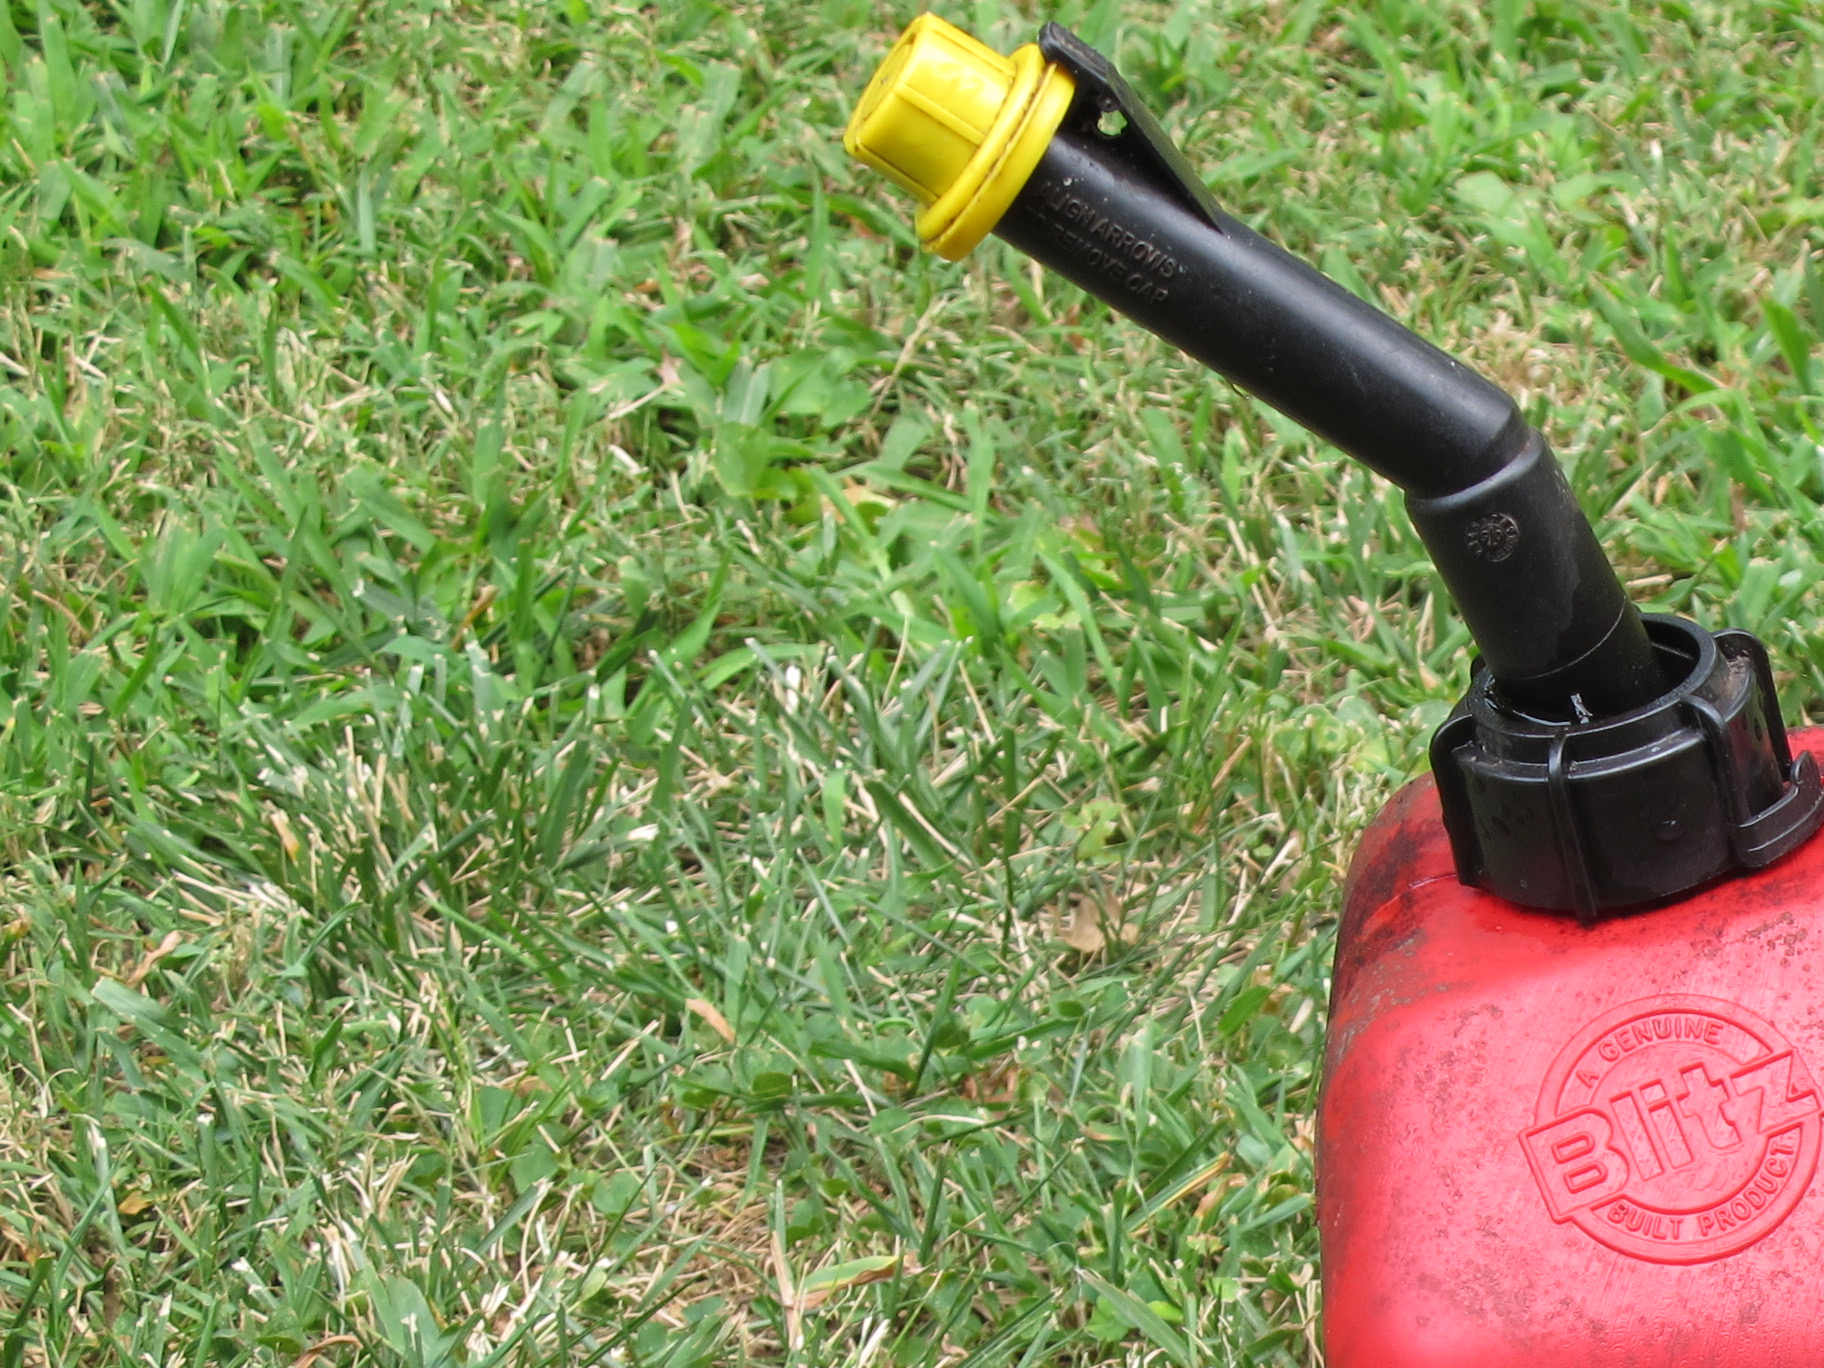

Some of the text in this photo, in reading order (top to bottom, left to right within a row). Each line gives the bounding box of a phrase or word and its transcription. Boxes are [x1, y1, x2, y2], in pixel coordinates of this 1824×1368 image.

[1126, 271, 1169, 304] CAP
[1577, 1016, 1725, 1089] A GENUINE
[1607, 1136, 1796, 1241] BUILT PRODUCT
